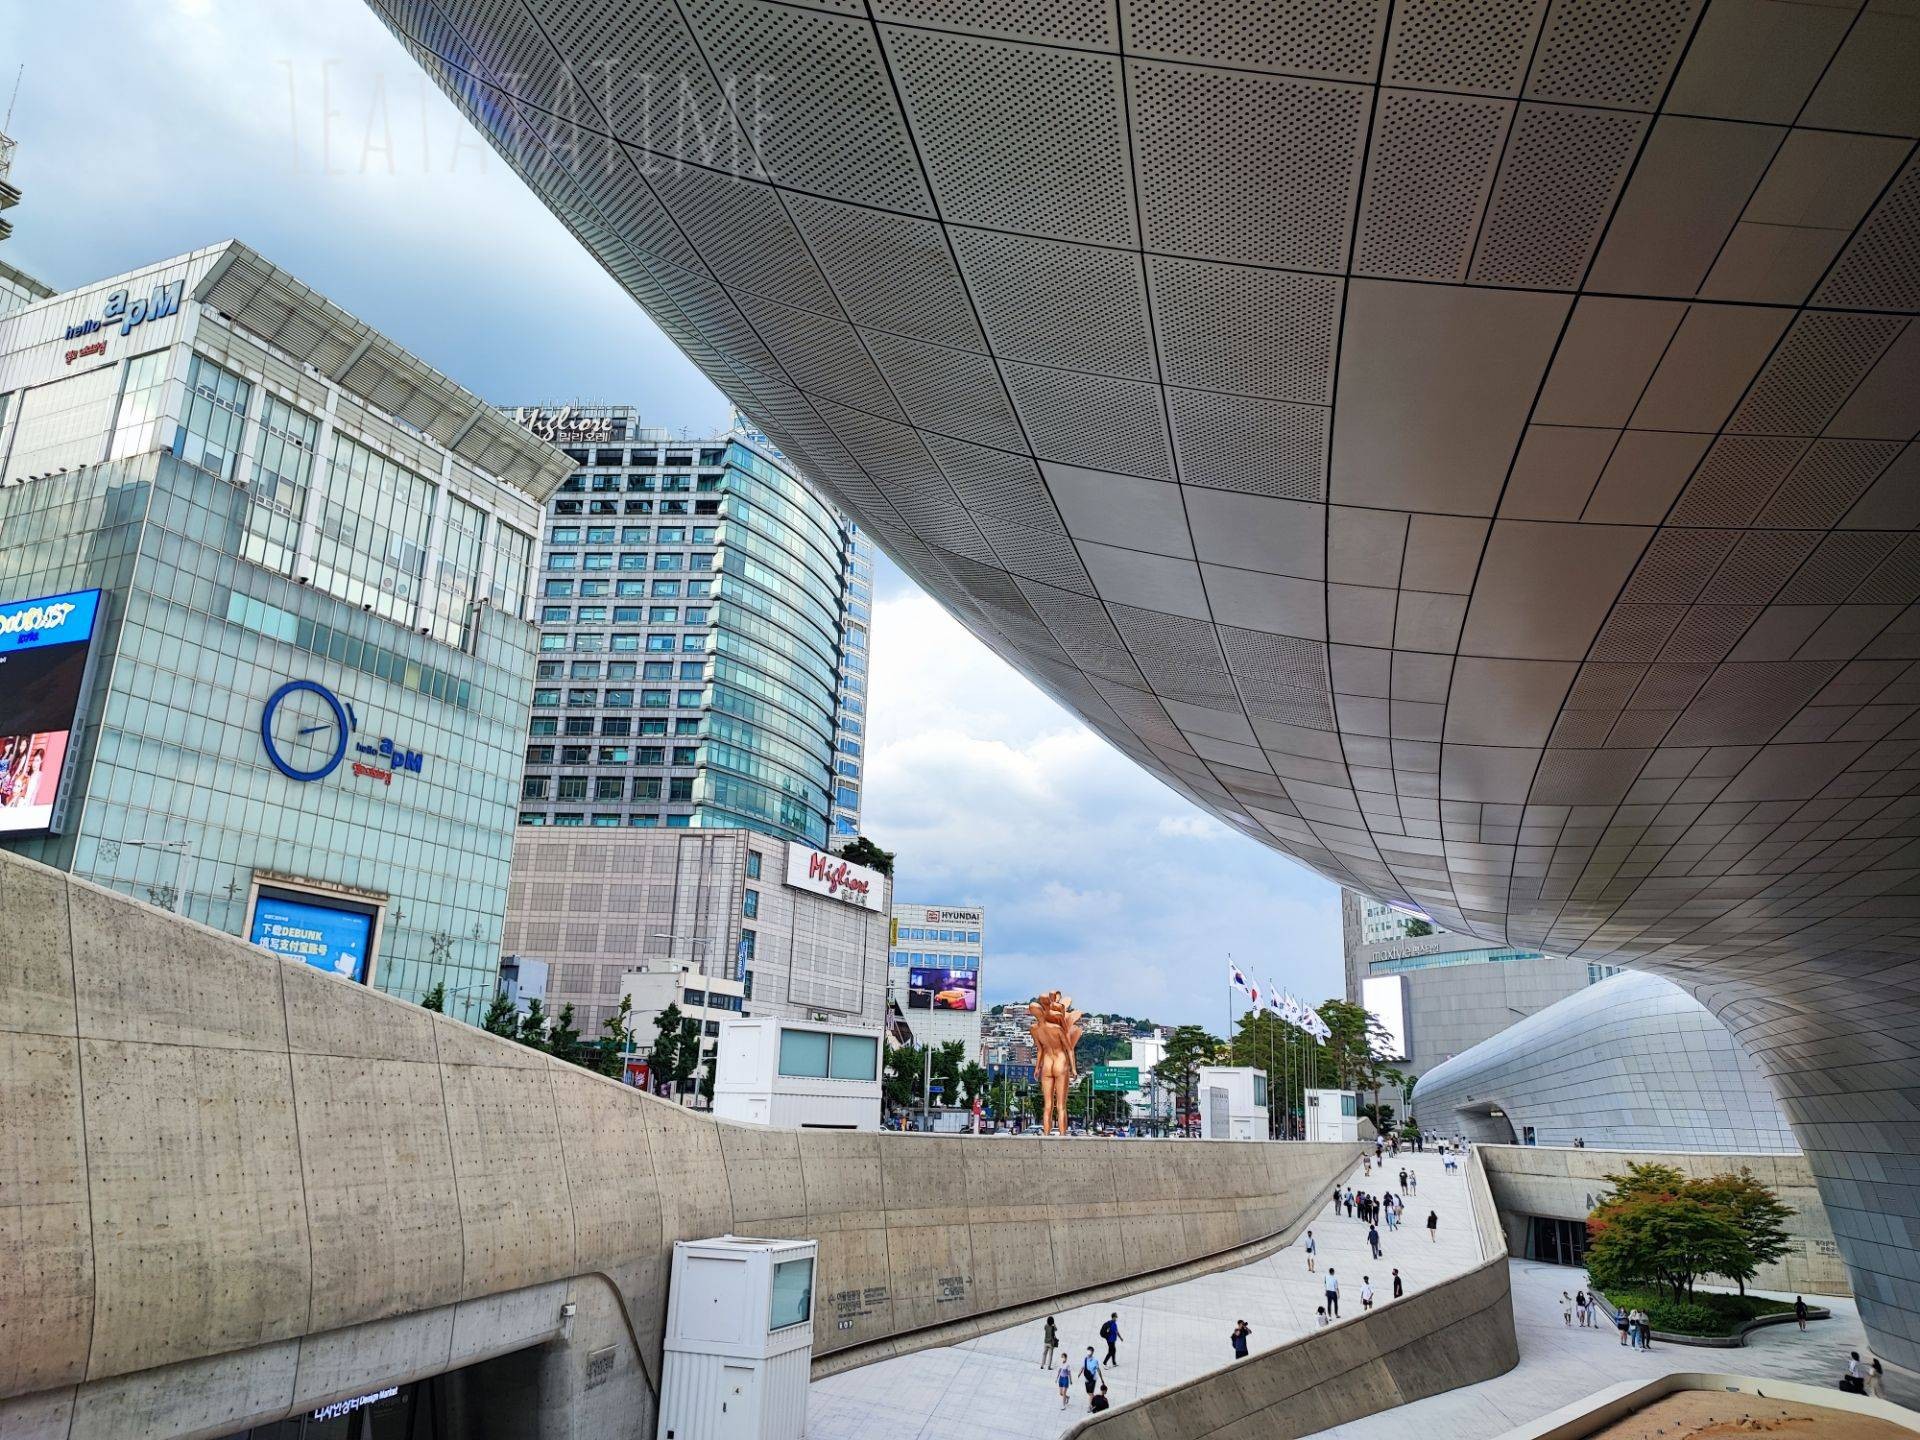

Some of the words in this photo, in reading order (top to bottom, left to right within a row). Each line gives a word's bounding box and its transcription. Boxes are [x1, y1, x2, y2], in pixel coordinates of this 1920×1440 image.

[64, 319, 101, 340] hello
[516, 406, 613, 441] Migliore
[560, 431, 611, 441] 밀리오레
[809, 852, 869, 894] Migliore
[941, 911, 980, 921] HYUNDAI
[380, 1386, 398, 1399] Market
